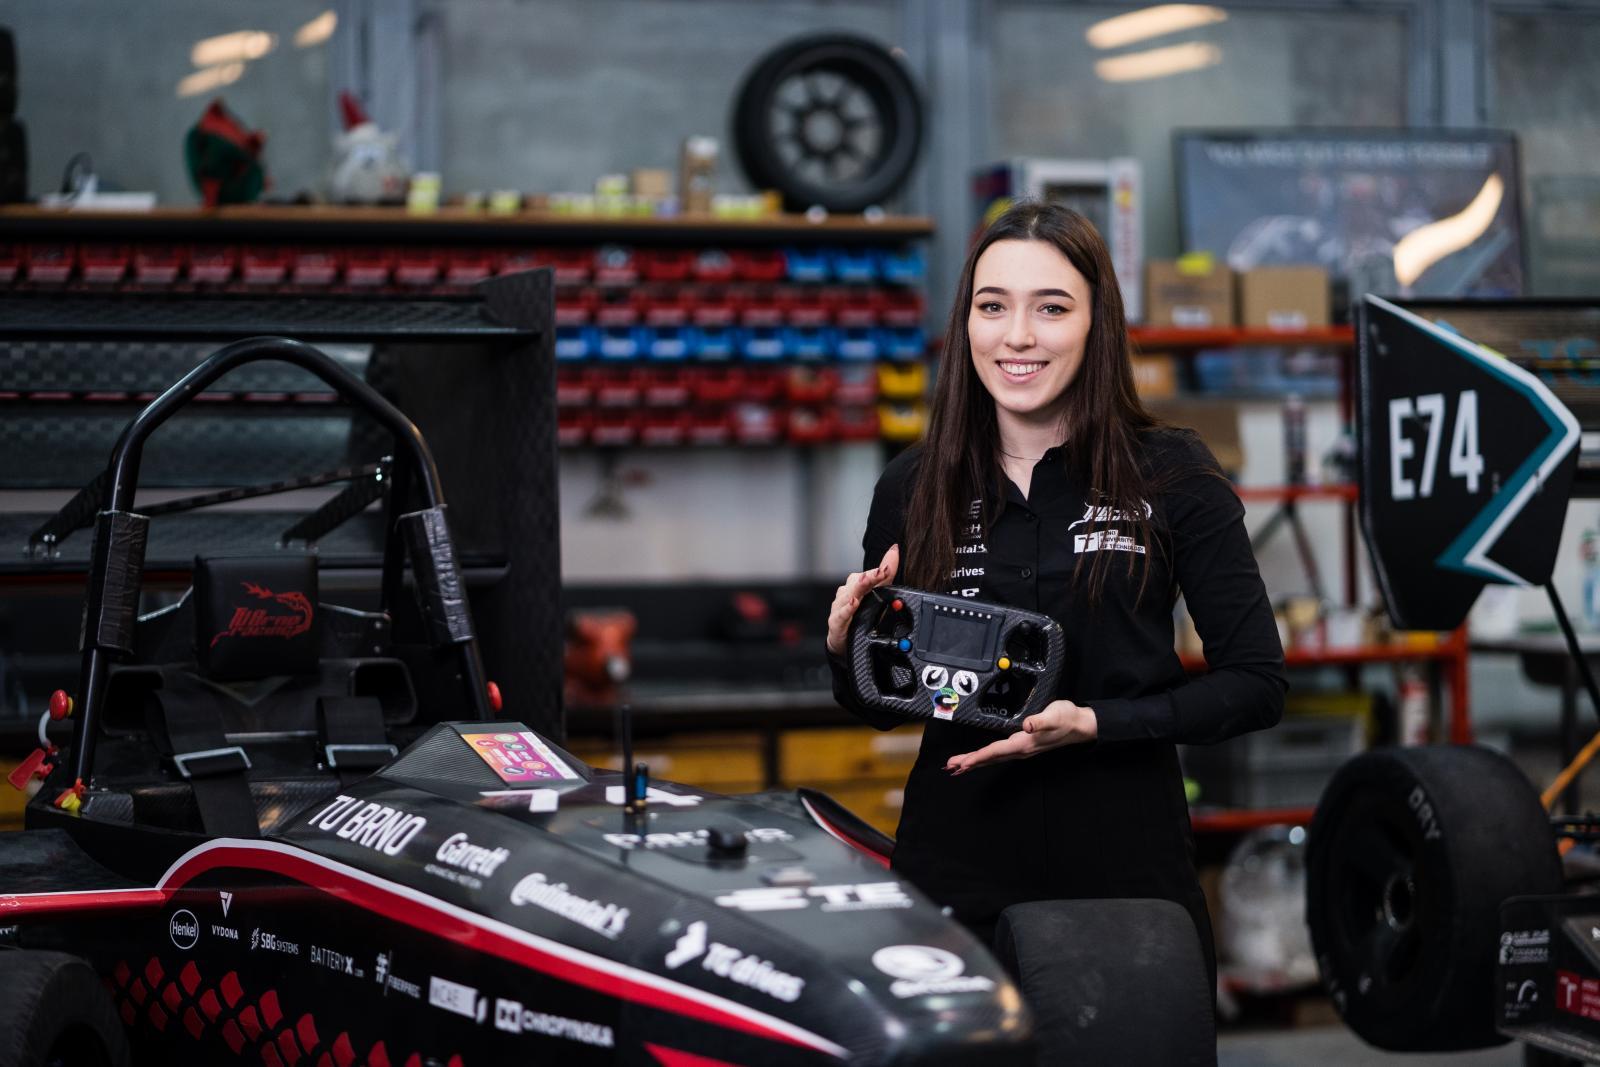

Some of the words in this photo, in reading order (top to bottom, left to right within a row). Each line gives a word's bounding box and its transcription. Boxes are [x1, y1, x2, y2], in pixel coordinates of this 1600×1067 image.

[1389, 390, 1484, 500] E74
[308, 795, 364, 830] TU
[336, 803, 427, 856] BRNO
[1408, 785, 1440, 839] DRY
[436, 832, 510, 877] Garrett
[172, 921, 197, 936] Henkel
[212, 925, 239, 940] VYDONA
[261, 932, 276, 950] SBG
[276, 940, 299, 955] SYSTEMS
